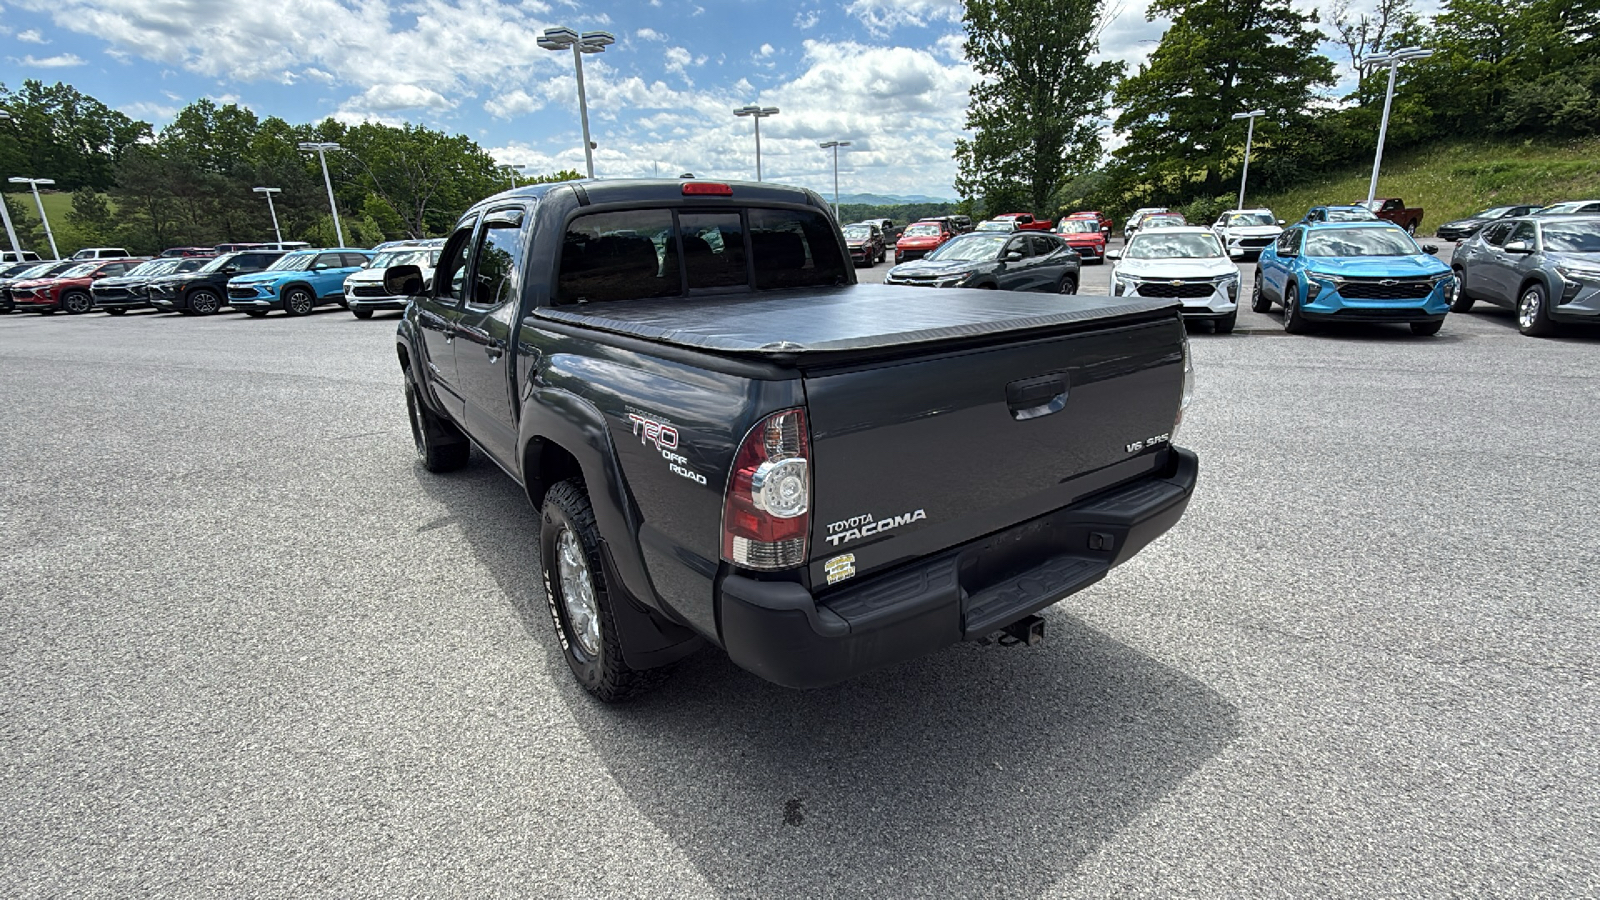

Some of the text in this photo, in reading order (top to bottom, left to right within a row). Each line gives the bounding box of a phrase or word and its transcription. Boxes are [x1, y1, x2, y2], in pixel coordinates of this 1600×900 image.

[628, 413, 679, 452] TRD
[662, 449, 688, 465] OFF
[1126, 441, 1142, 453] V6
[669, 462, 707, 485] ROAD
[825, 508, 927, 546] TACOMA
[826, 513, 874, 534] TOYOTA
